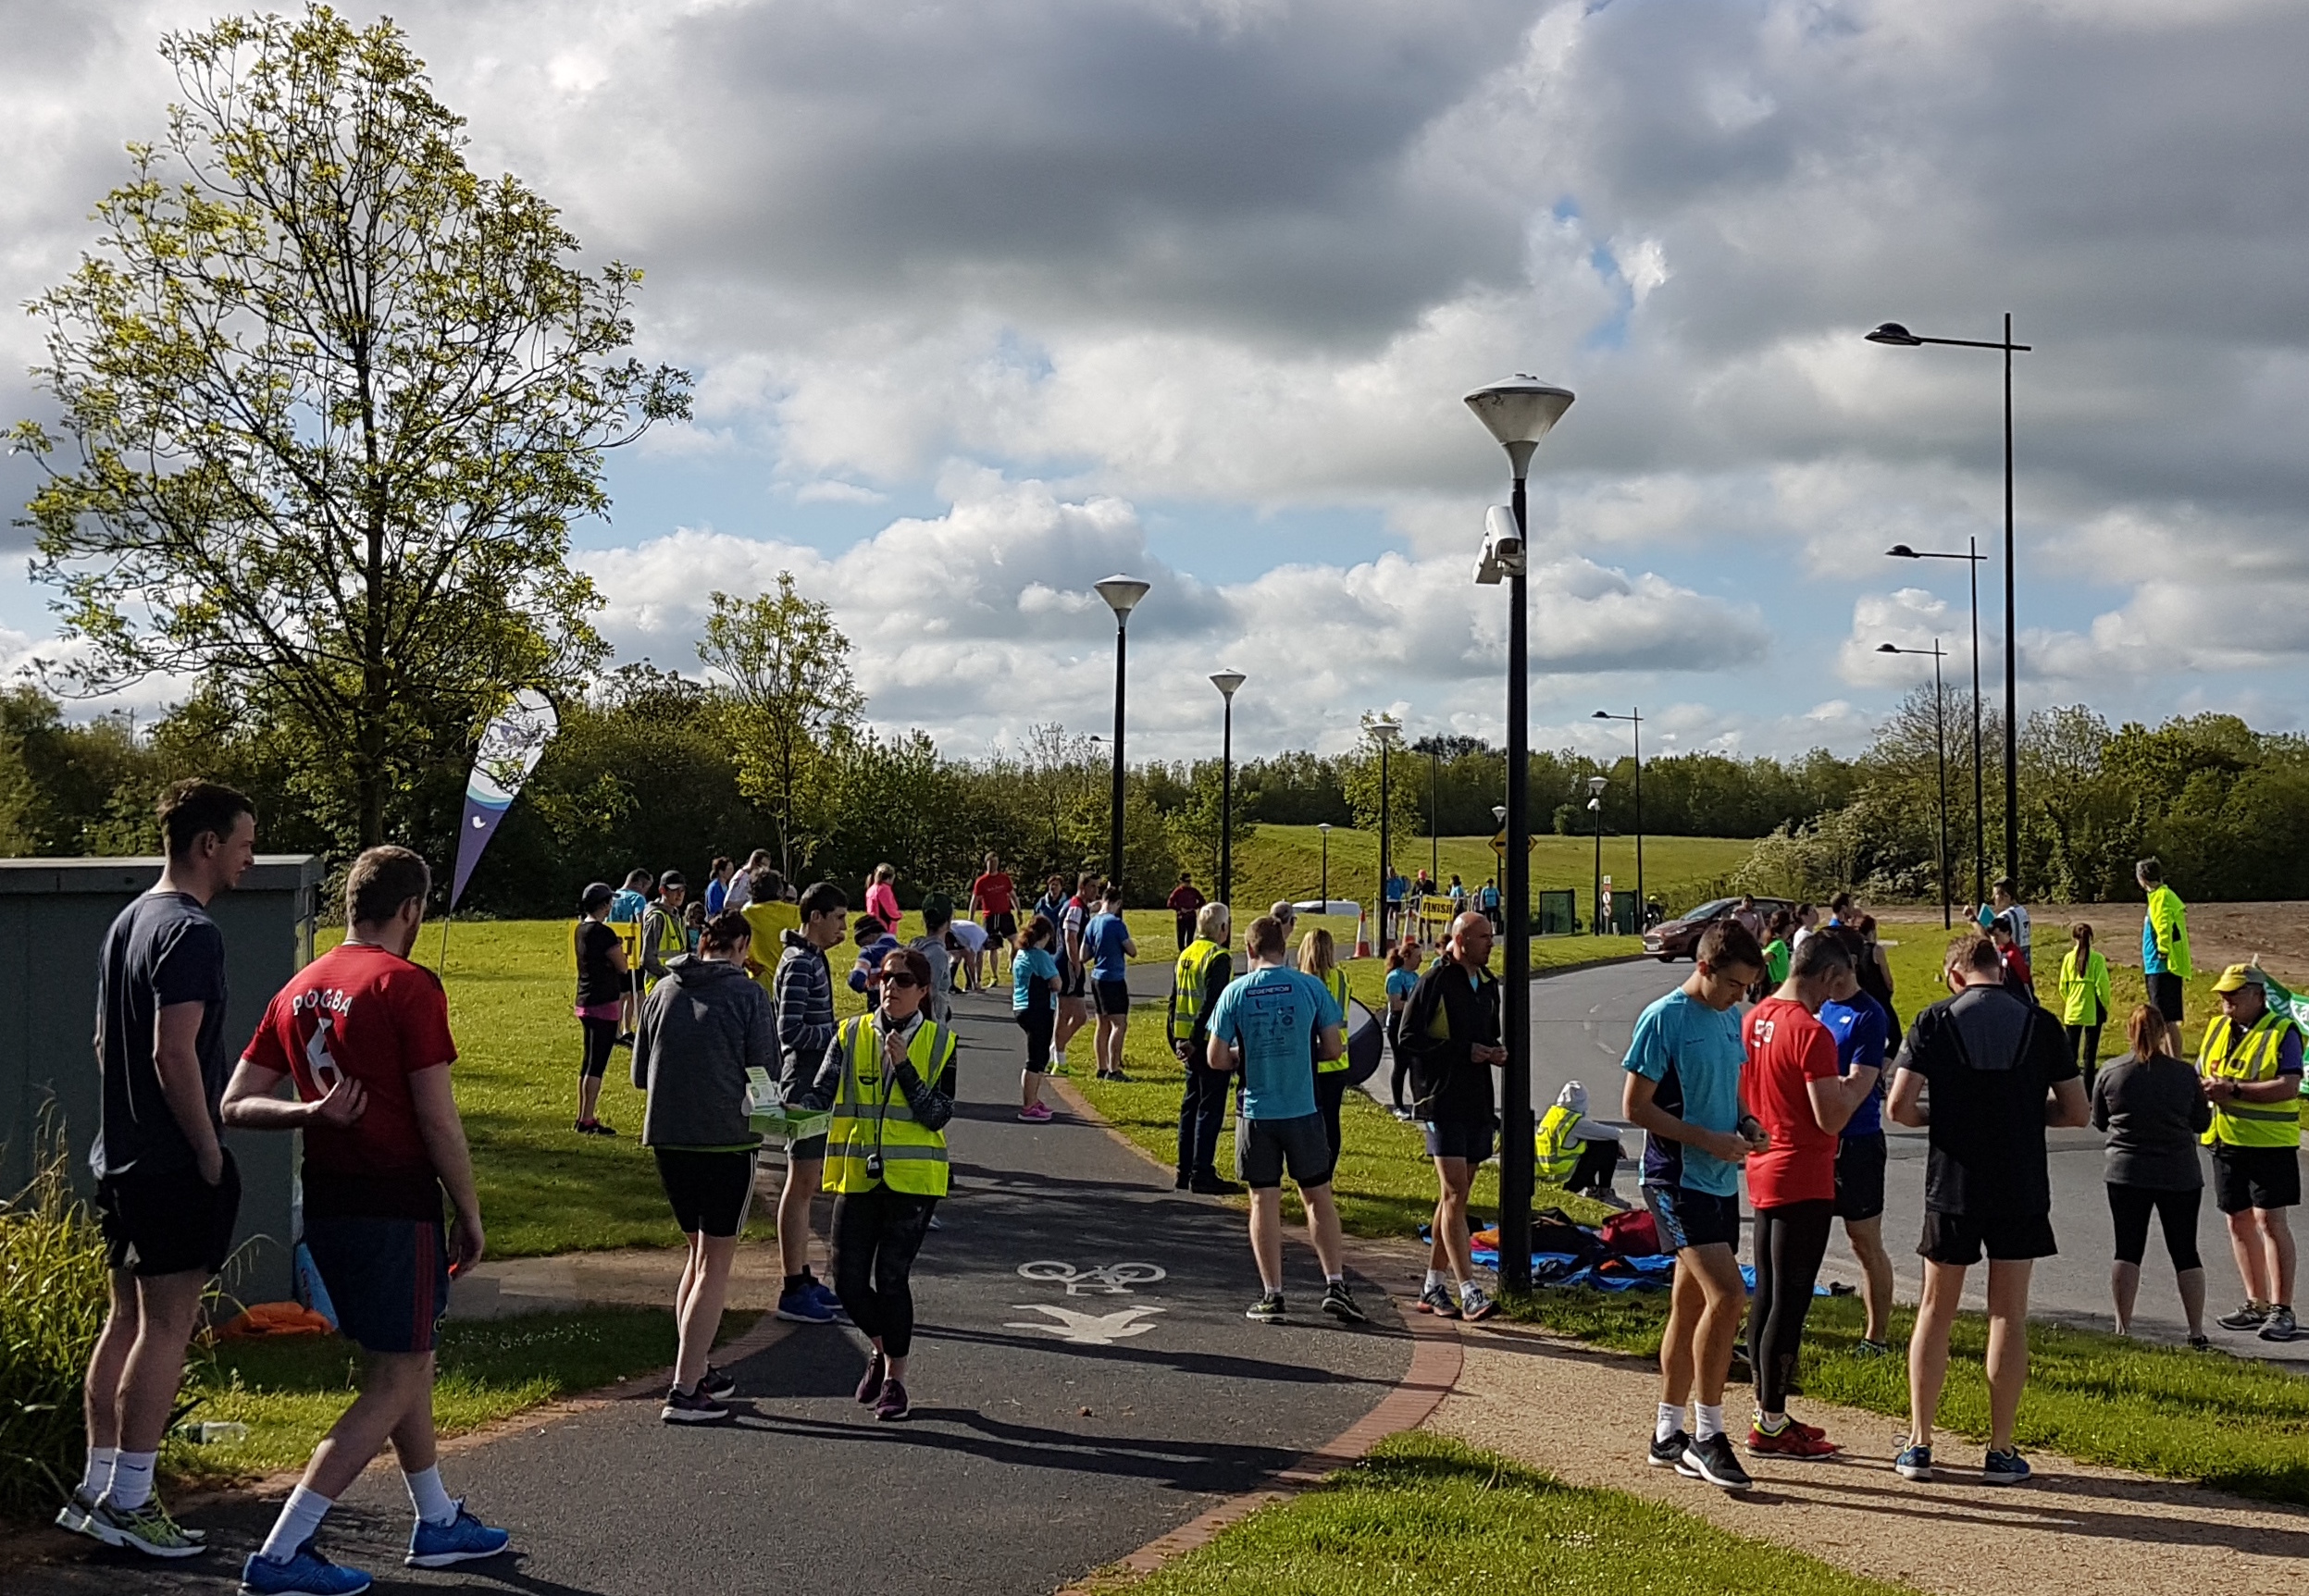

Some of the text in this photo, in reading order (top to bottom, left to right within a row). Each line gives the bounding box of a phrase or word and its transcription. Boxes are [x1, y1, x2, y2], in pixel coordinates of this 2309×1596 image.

[1422, 901, 1452, 914] FINISH
[292, 988, 354, 1017] POGBA
[306, 1018, 344, 1096] 6
